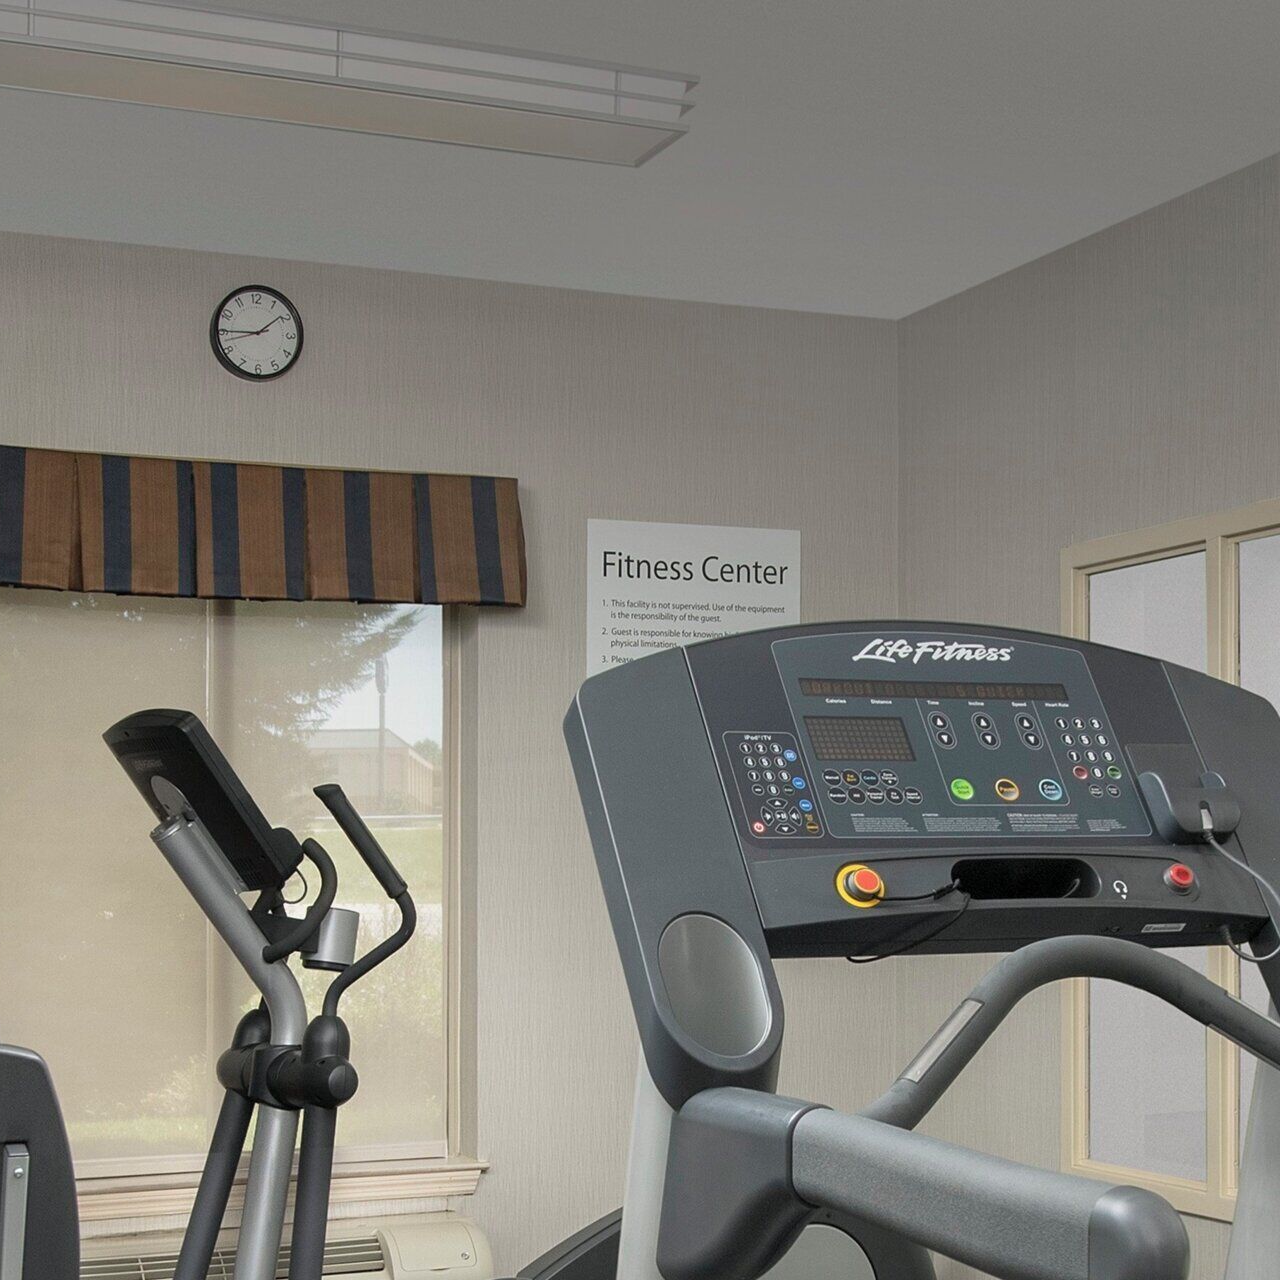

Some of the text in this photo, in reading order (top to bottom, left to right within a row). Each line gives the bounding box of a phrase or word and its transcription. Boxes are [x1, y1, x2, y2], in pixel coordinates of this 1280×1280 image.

[251, 293, 262, 305] 12
[270, 300, 277, 309] 1
[221, 309, 233, 321] 10
[280, 313, 291, 324] 2
[285, 332, 296, 340] 3
[224, 345, 233, 355] 8
[283, 349, 292, 358] 4
[238, 358, 247, 367] 7
[270, 360, 280, 371] 5
[254, 364, 262, 375] 6
[602, 550, 788, 585] Fitness Center
[611, 599, 626, 608] This
[626, 599, 651, 610] facility
[651, 600, 657, 609] is
[672, 602, 710, 612] supervised.
[712, 603, 725, 611] Use
[726, 603, 734, 612] of
[734, 604, 747, 612] the
[747, 605, 785, 614] equipment
[610, 610, 722, 623] is the responsibility of the guest.
[611, 627, 632, 636] Guest
[633, 628, 639, 636] is
[640, 629, 681, 638] responsible
[681, 629, 692, 638] for
[610, 639, 639, 648] physical
